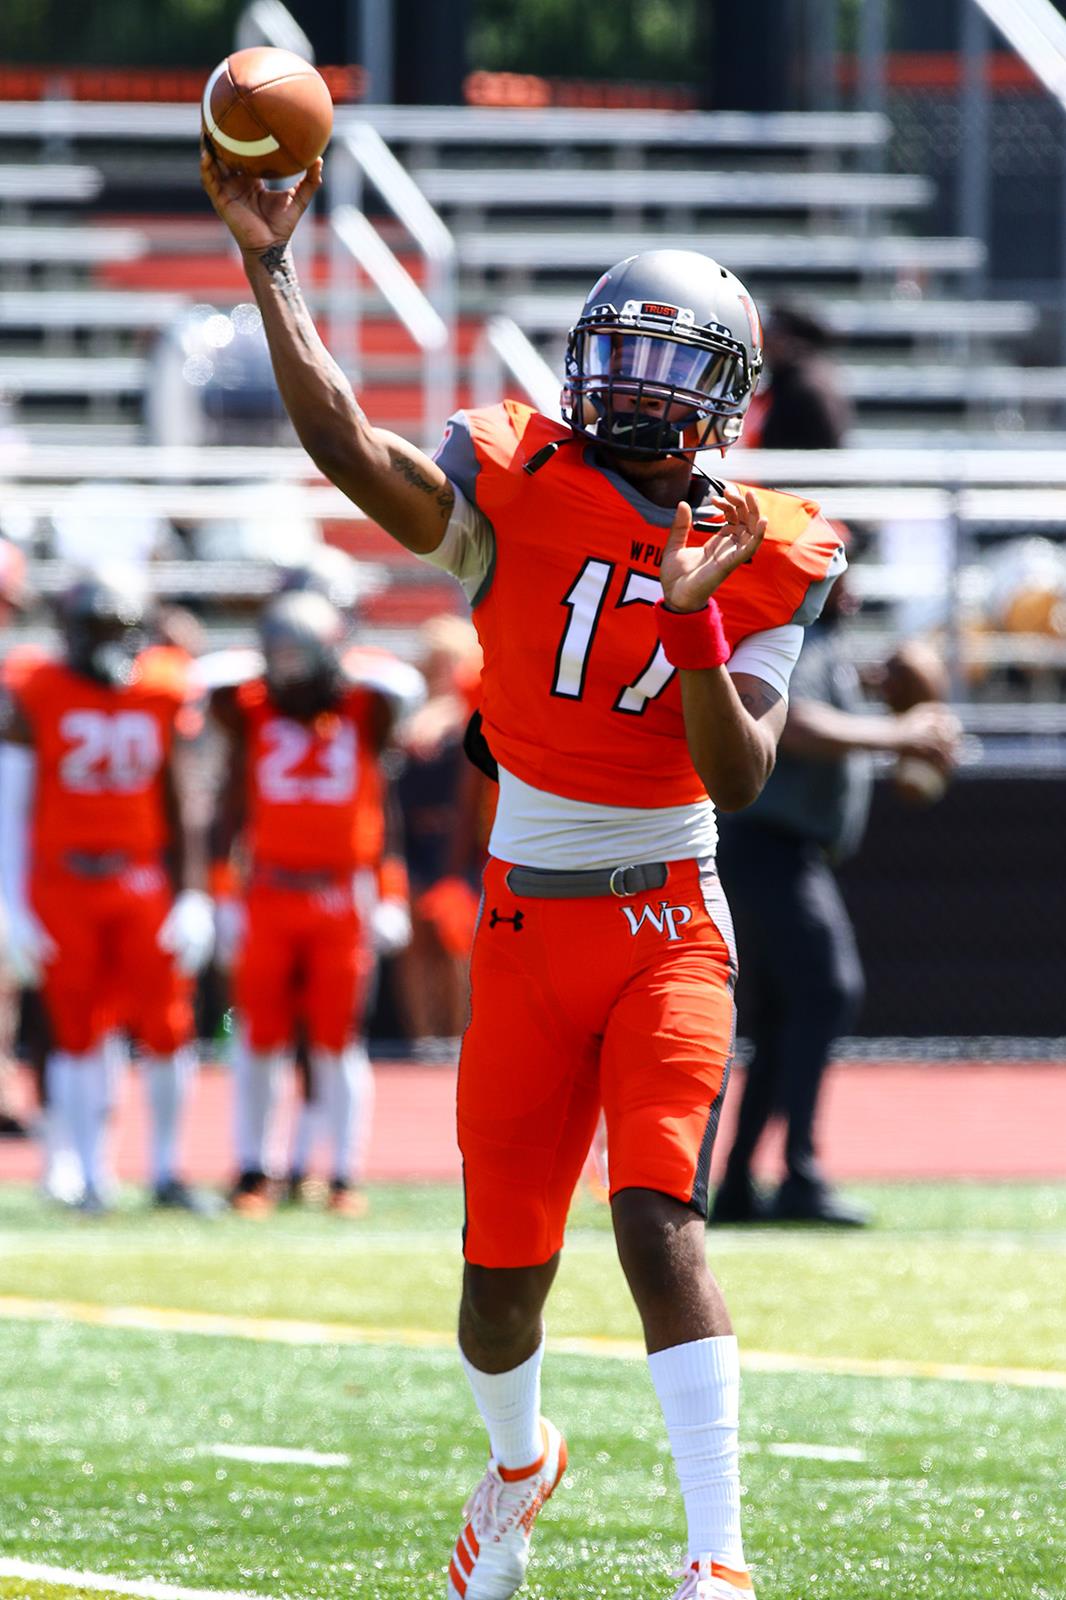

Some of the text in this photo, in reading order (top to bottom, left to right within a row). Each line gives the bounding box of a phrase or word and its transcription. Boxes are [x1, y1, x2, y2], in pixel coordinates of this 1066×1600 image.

[645, 304, 677, 317] TRUST
[550, 556, 678, 716] 17
[60, 709, 162, 794] 20
[621, 902, 692, 941] WP
